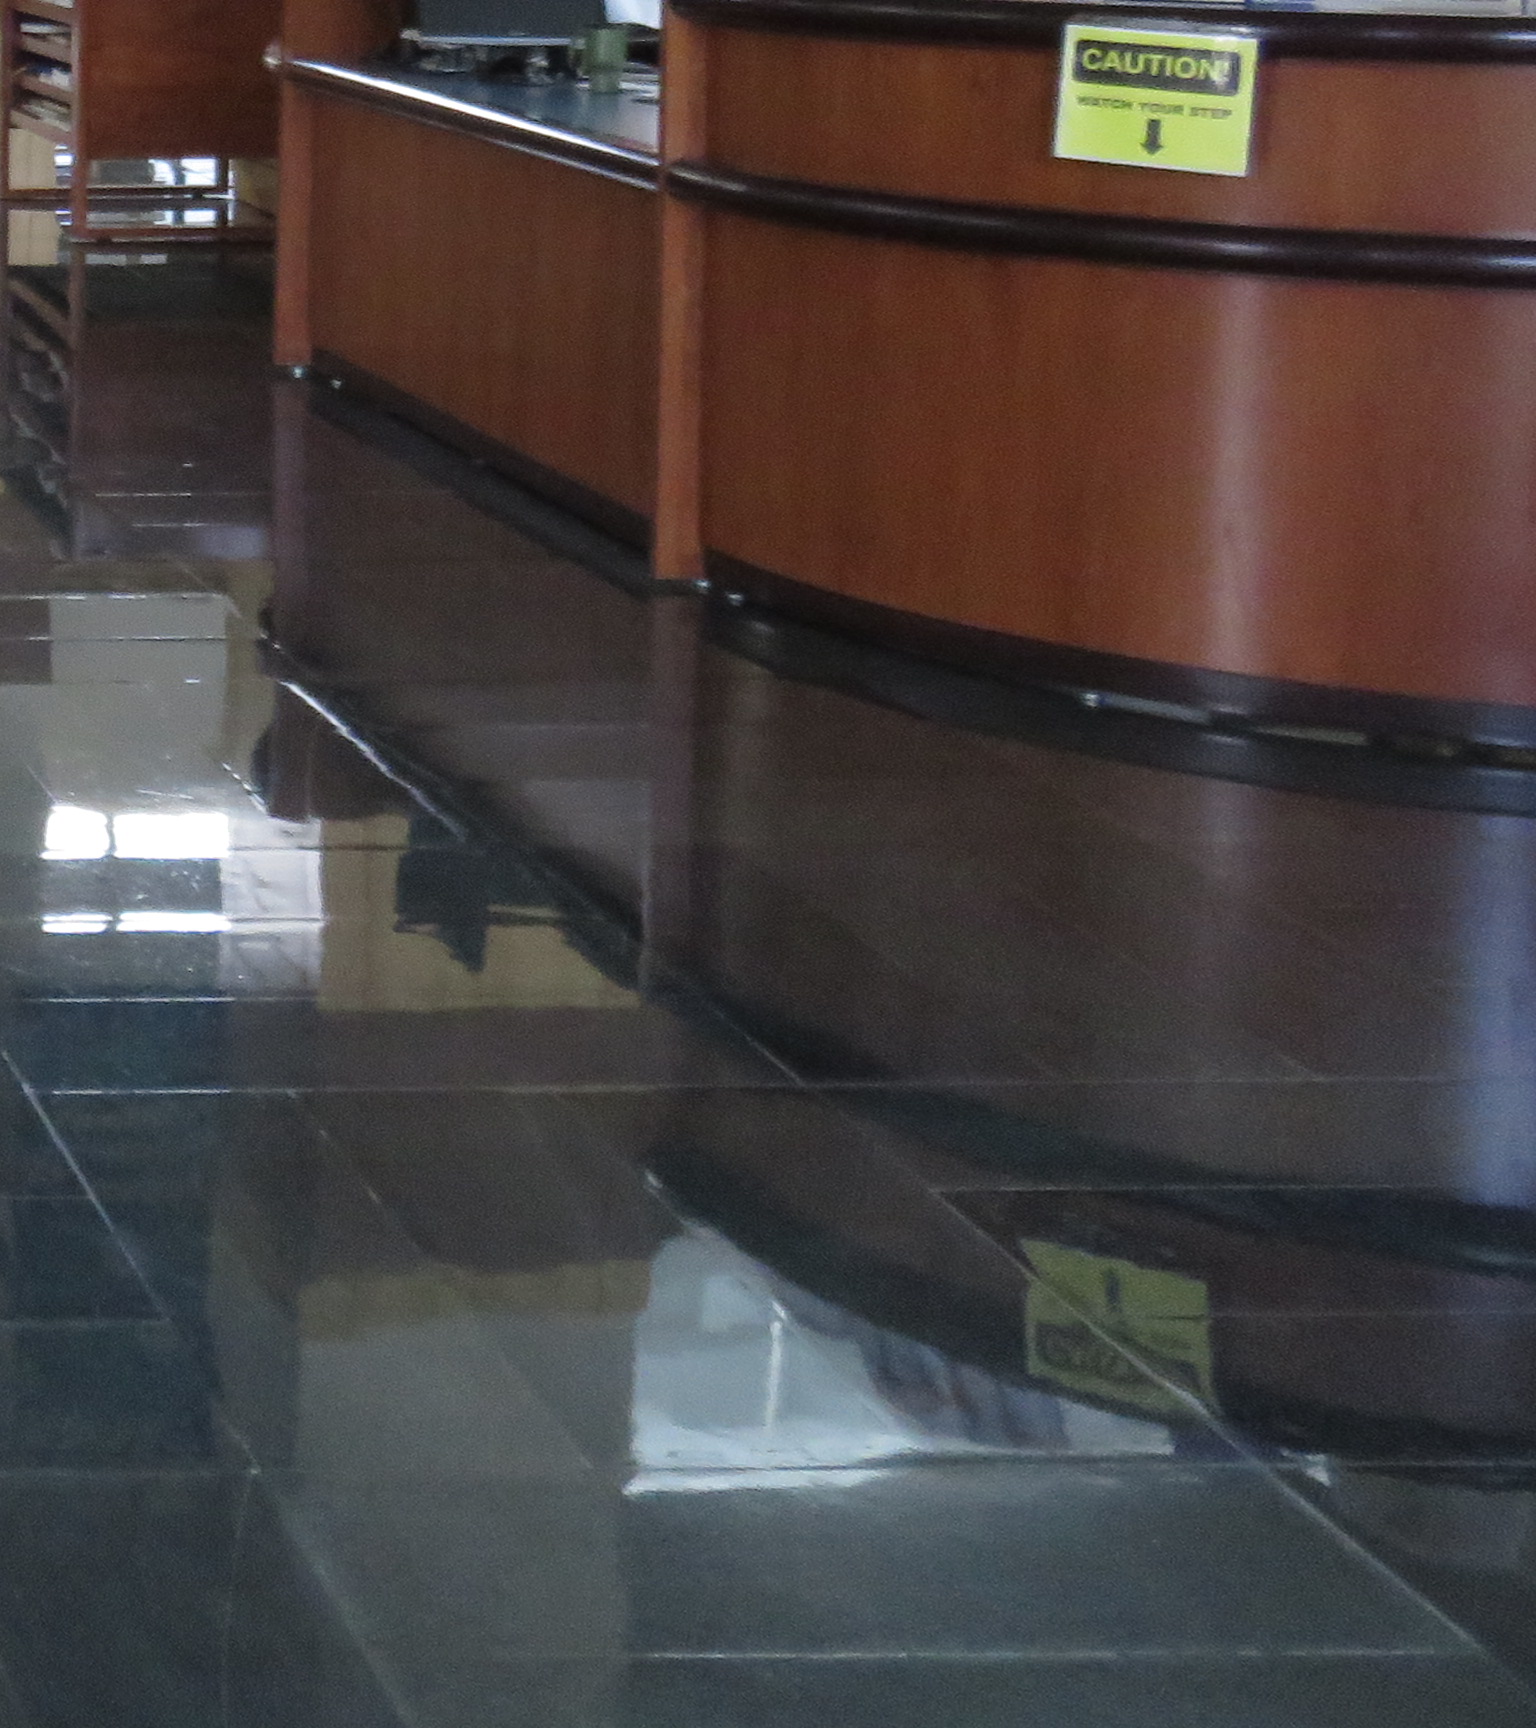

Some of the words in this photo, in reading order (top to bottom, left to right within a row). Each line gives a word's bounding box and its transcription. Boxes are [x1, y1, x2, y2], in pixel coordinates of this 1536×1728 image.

[1081, 47, 1232, 85] CAUTION!
[1139, 101, 1185, 116] YOUR
[1188, 106, 1233, 120] STEP
